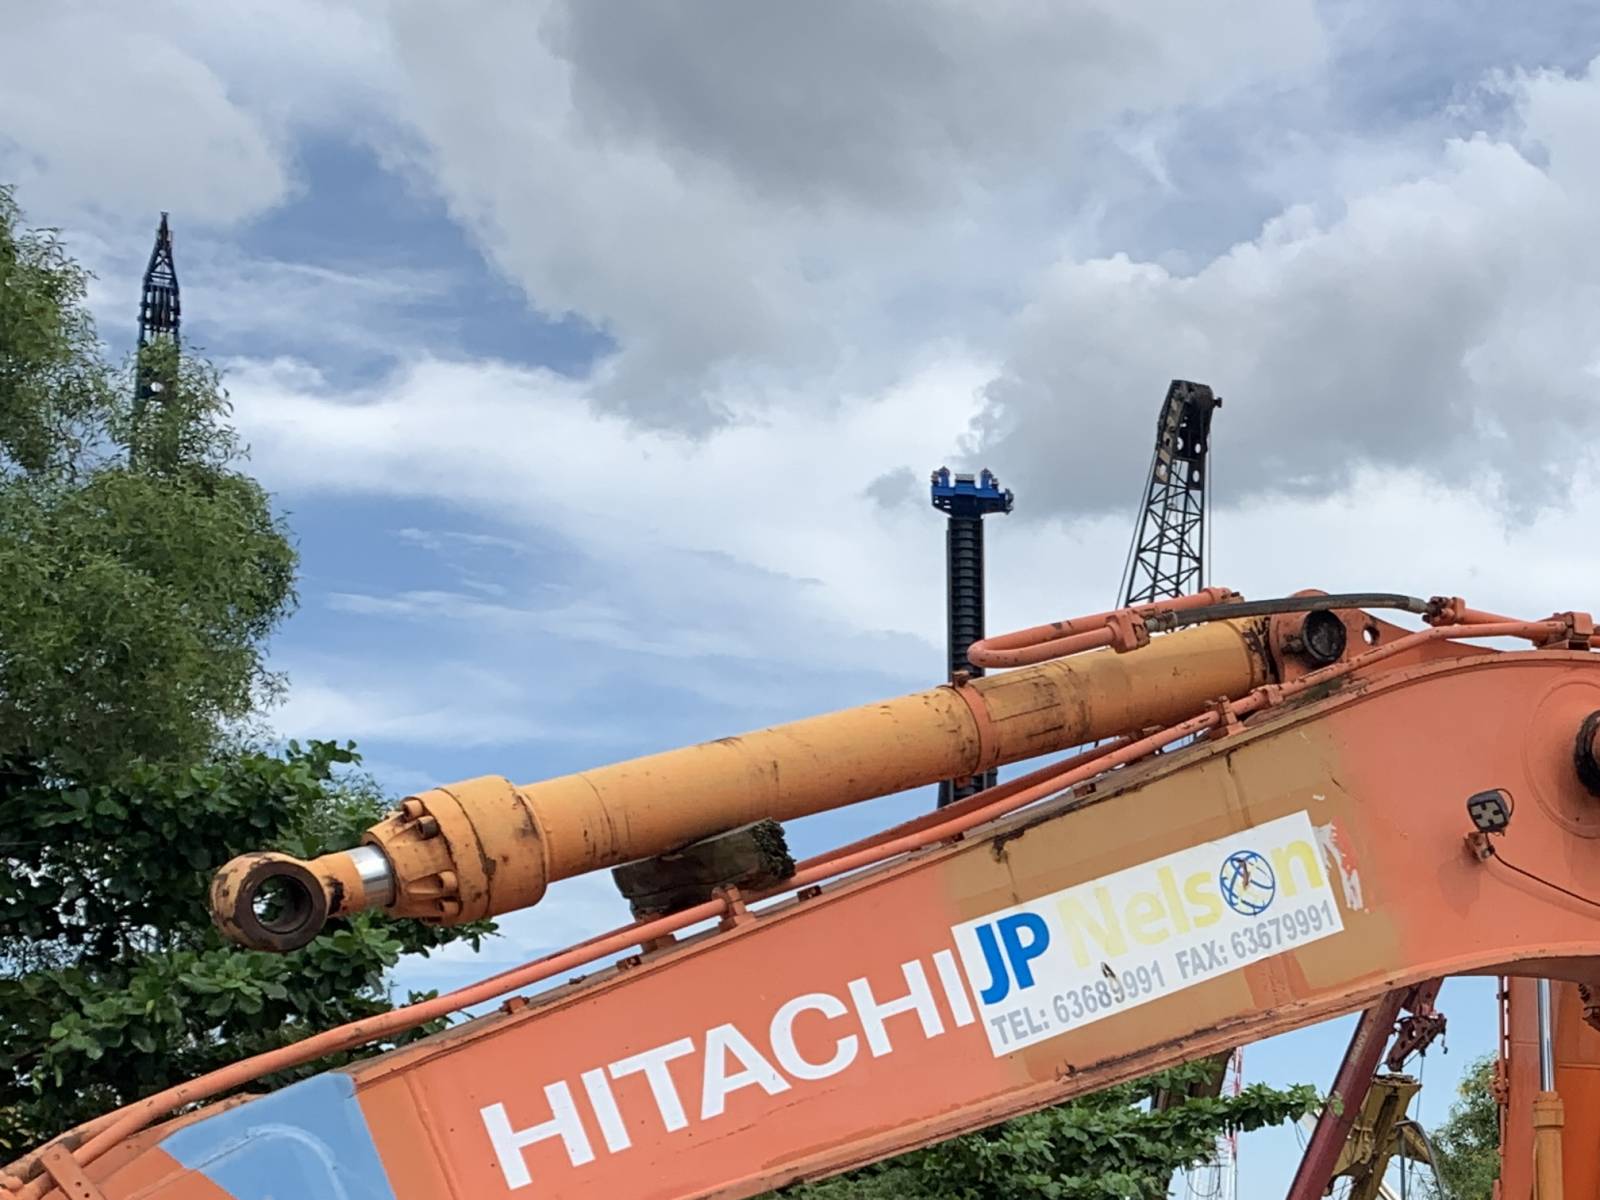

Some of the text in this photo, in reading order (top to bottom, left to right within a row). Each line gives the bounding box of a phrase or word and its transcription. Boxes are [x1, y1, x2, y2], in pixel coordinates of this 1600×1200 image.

[975, 912, 1050, 1005] JP
[991, 900, 1335, 1046] TEL: 63689991 FAX: 63679991
[480, 948, 977, 1190] HITACHI
